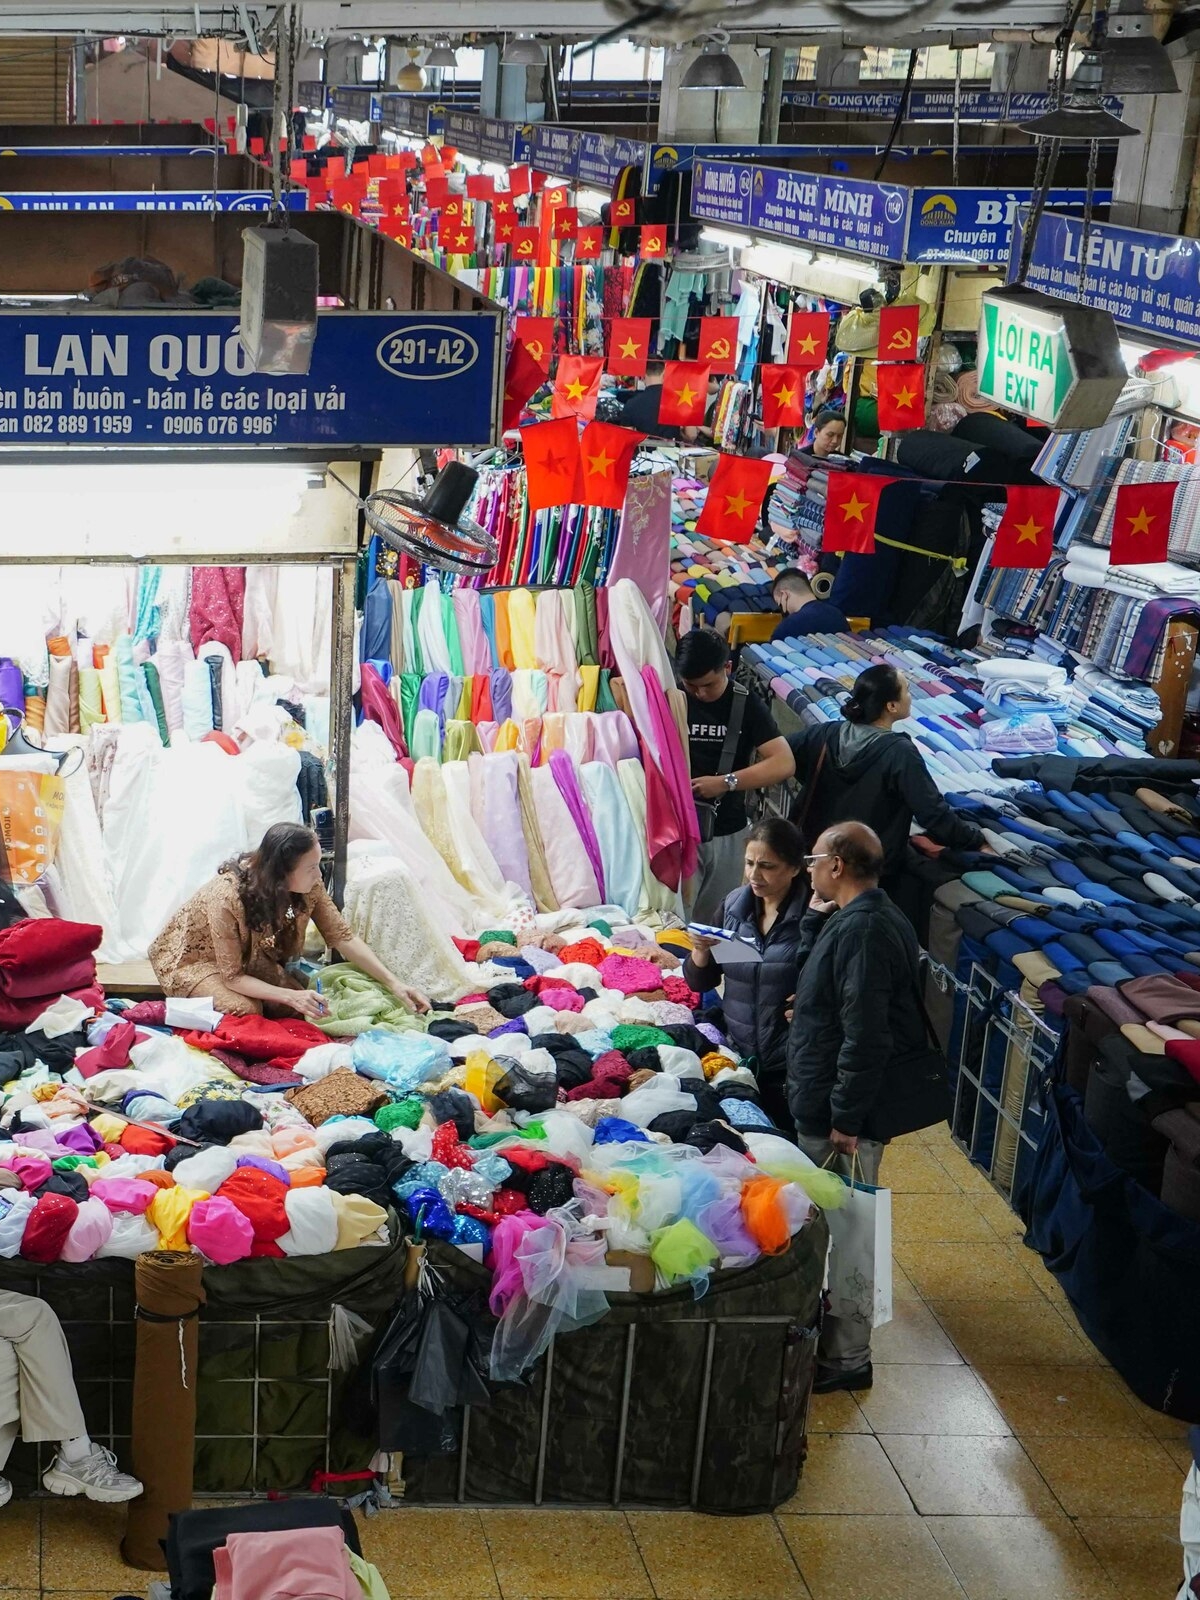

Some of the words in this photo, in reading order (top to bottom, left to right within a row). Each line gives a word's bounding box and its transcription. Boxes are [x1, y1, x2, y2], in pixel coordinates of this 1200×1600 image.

[828, 95, 862, 106] DUNG
[925, 94, 954, 104] DUNG
[776, 174, 817, 206] BÌNH
[765, 202, 783, 217] Chuyên
[841, 216, 853, 231] các
[857, 219, 870, 238] loại
[873, 221, 884, 237] vải
[944, 229, 997, 245] Chuyên
[1063, 230, 1120, 272] LIÊN
[972, 248, 994, 260] 0961
[997, 248, 1010, 260] 08
[1051, 266, 1063, 284] bán
[1108, 280, 1123, 297] các
[1123, 282, 1139, 304] loại
[1155, 315, 1174, 330] 0904
[1175, 320, 1200, 337] 80068
[24, 334, 129, 376] LAN
[388, 338, 465, 365] 291-A2
[1028, 331, 1054, 374] RA
[24, 386, 63, 409] bán
[73, 386, 126, 410] buôn
[147, 385, 187, 410] bán
[194, 384, 214, 410] lẻ
[221, 385, 260, 410] các
[266, 387, 307, 415] loại
[314, 384, 346, 410] vải
[1005, 370, 1039, 411] EXIT
[23, 415, 53, 434] 082
[58, 415, 88, 434] 889
[93, 415, 132, 434] 1959
[164, 416, 203, 434] 0906
[208, 416, 238, 434] 076
[243, 416, 273, 434] 996
